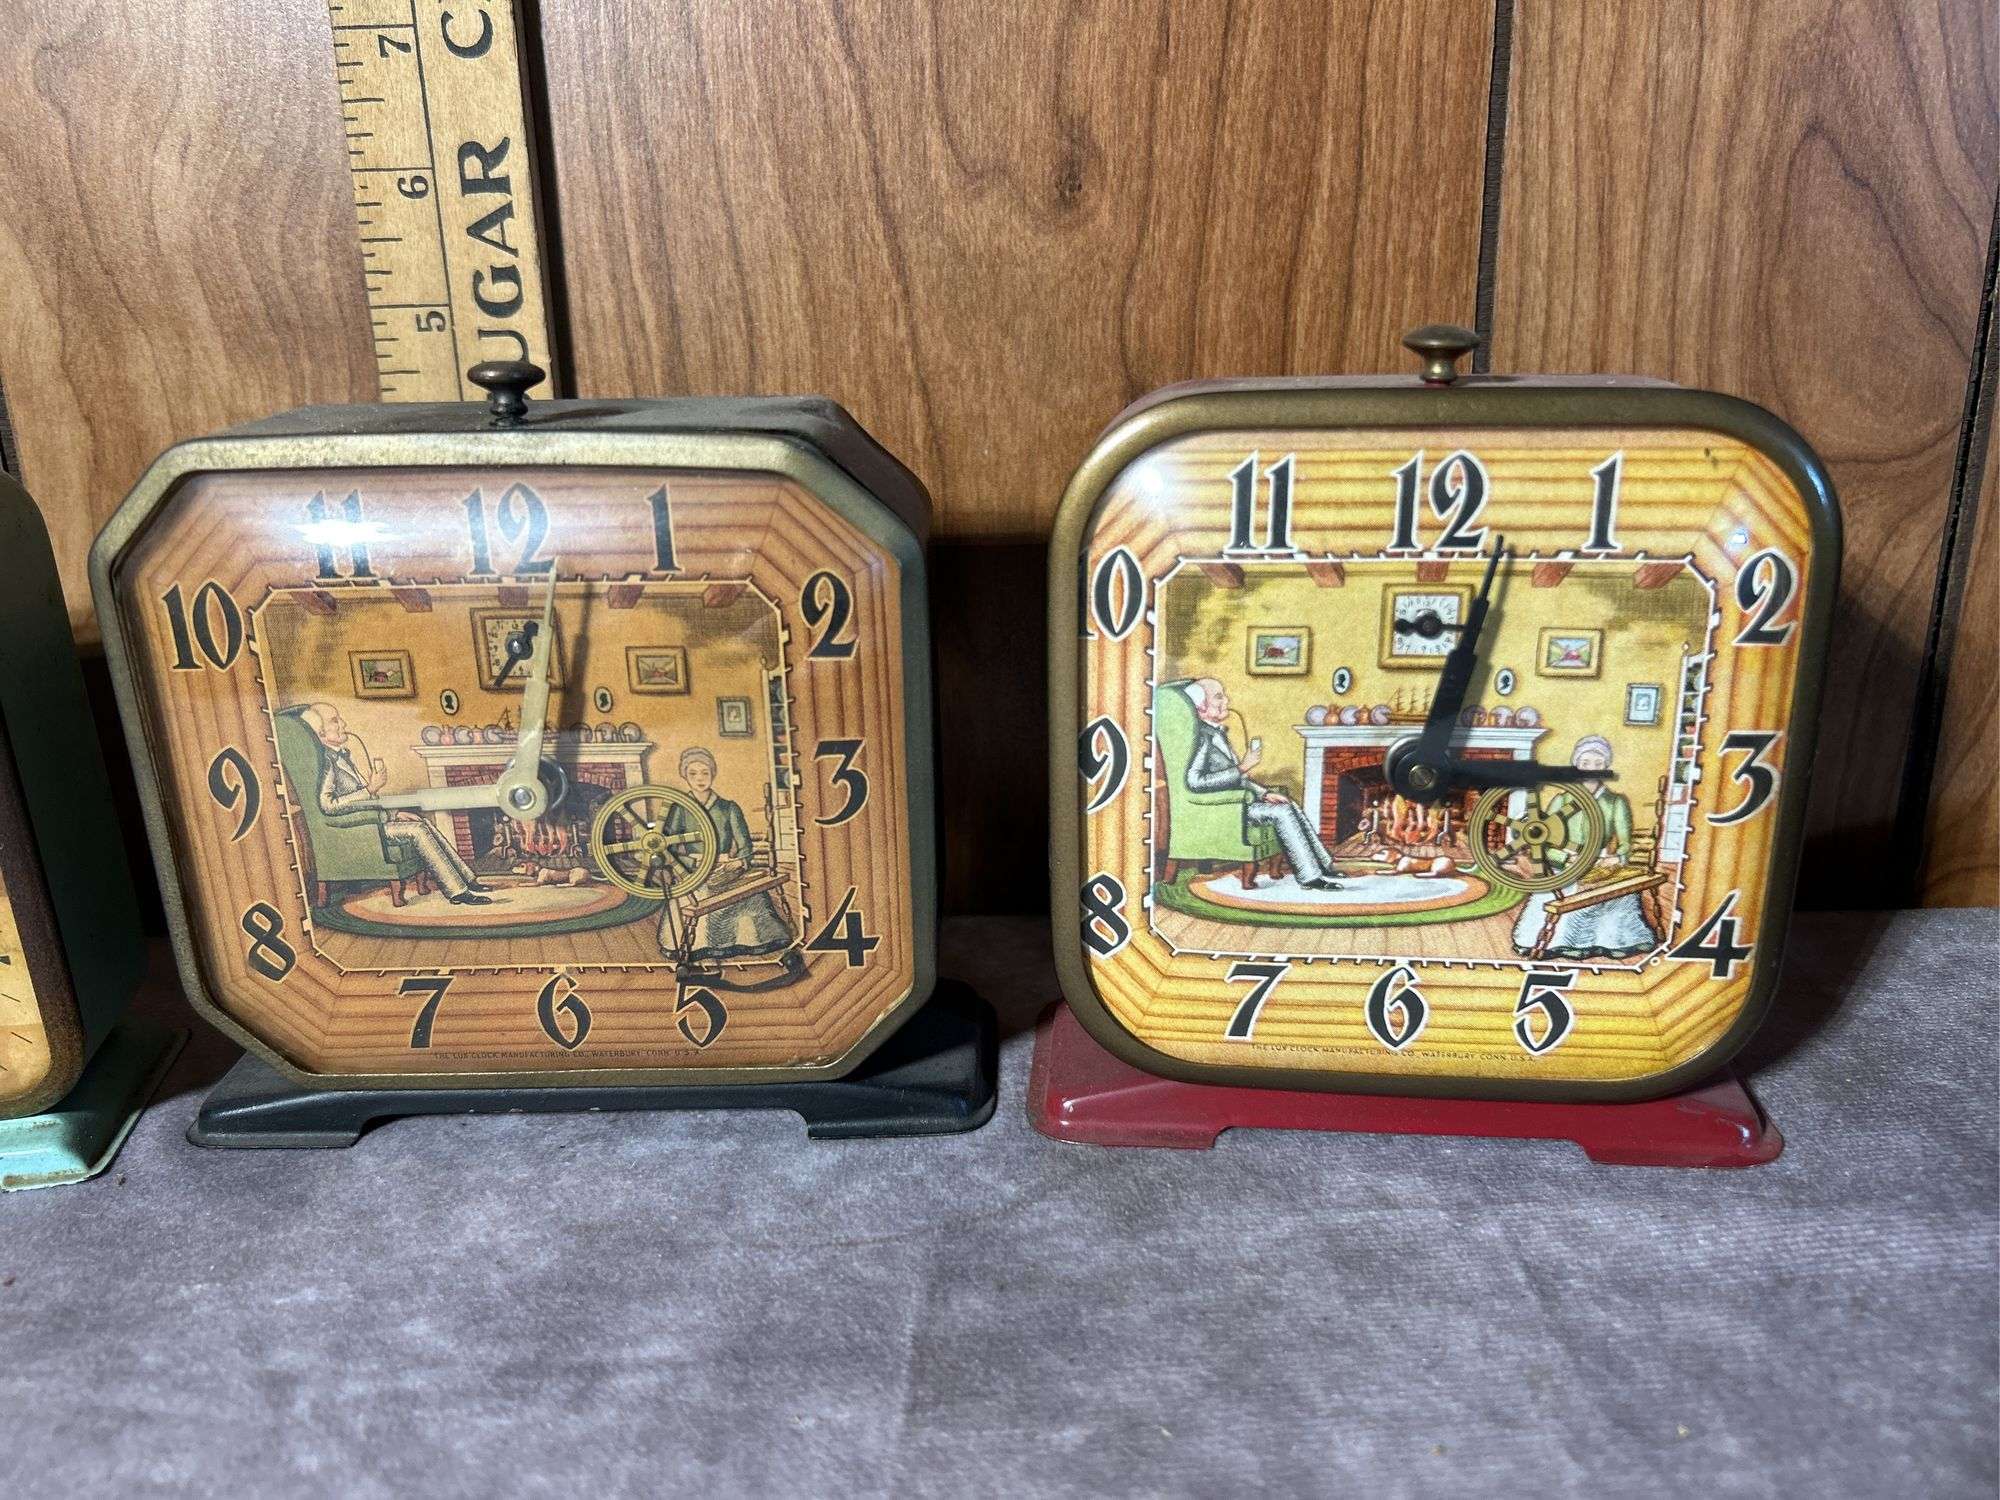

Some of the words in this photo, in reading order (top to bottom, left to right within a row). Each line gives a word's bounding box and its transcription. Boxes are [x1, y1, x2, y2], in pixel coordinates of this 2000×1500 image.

[378, 34, 412, 59] 7
[398, 174, 430, 200] 6
[416, 310, 446, 333] 5
[305, 487, 378, 579] 11
[462, 482, 558, 577] 12
[648, 483, 684, 574] 1
[1228, 449, 1297, 553] 11
[1390, 450, 1491, 552] 12
[1589, 451, 1622, 552] 1
[161, 582, 243, 673] 10
[802, 570, 857, 660] 2
[1735, 551, 1798, 646] 2
[207, 745, 262, 842] 9
[814, 739, 870, 826] 3
[1079, 715, 1130, 815] 9
[1706, 731, 1784, 825] 3
[241, 901, 297, 983] 8
[803, 887, 880, 968] 4
[1079, 871, 1133, 959] 8
[1663, 890, 1754, 979] 4
[398, 976, 453, 1050] 7
[536, 974, 593, 1051] 6
[674, 981, 727, 1049] 5
[1223, 963, 1289, 1040] 7
[1366, 965, 1428, 1053] 6
[1513, 968, 1579, 1056] 5
